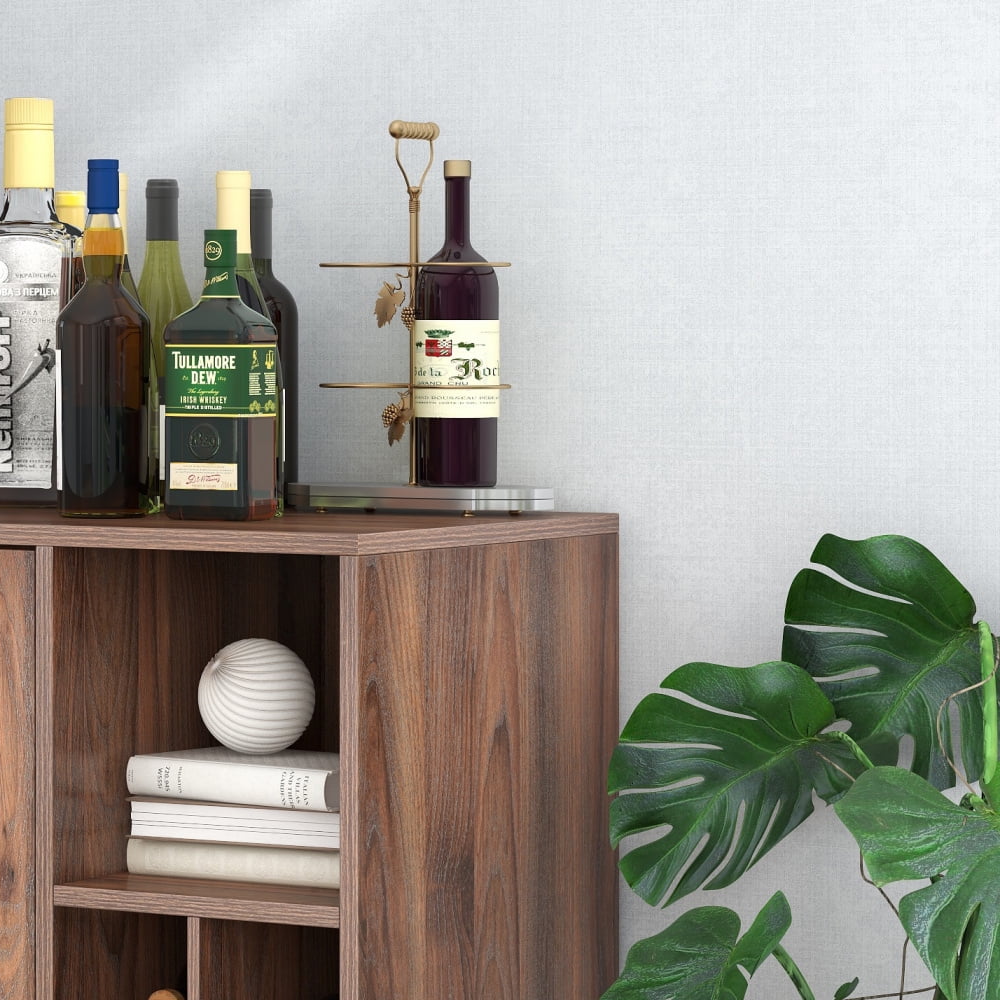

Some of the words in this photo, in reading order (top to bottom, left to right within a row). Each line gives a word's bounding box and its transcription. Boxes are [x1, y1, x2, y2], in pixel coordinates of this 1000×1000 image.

[23, 287, 59, 298] ПЕРЦЕМ
[171, 351, 236, 369] TULLAMORE
[180, 395, 197, 404] IRISH
[199, 395, 227, 404] WHISKEY
